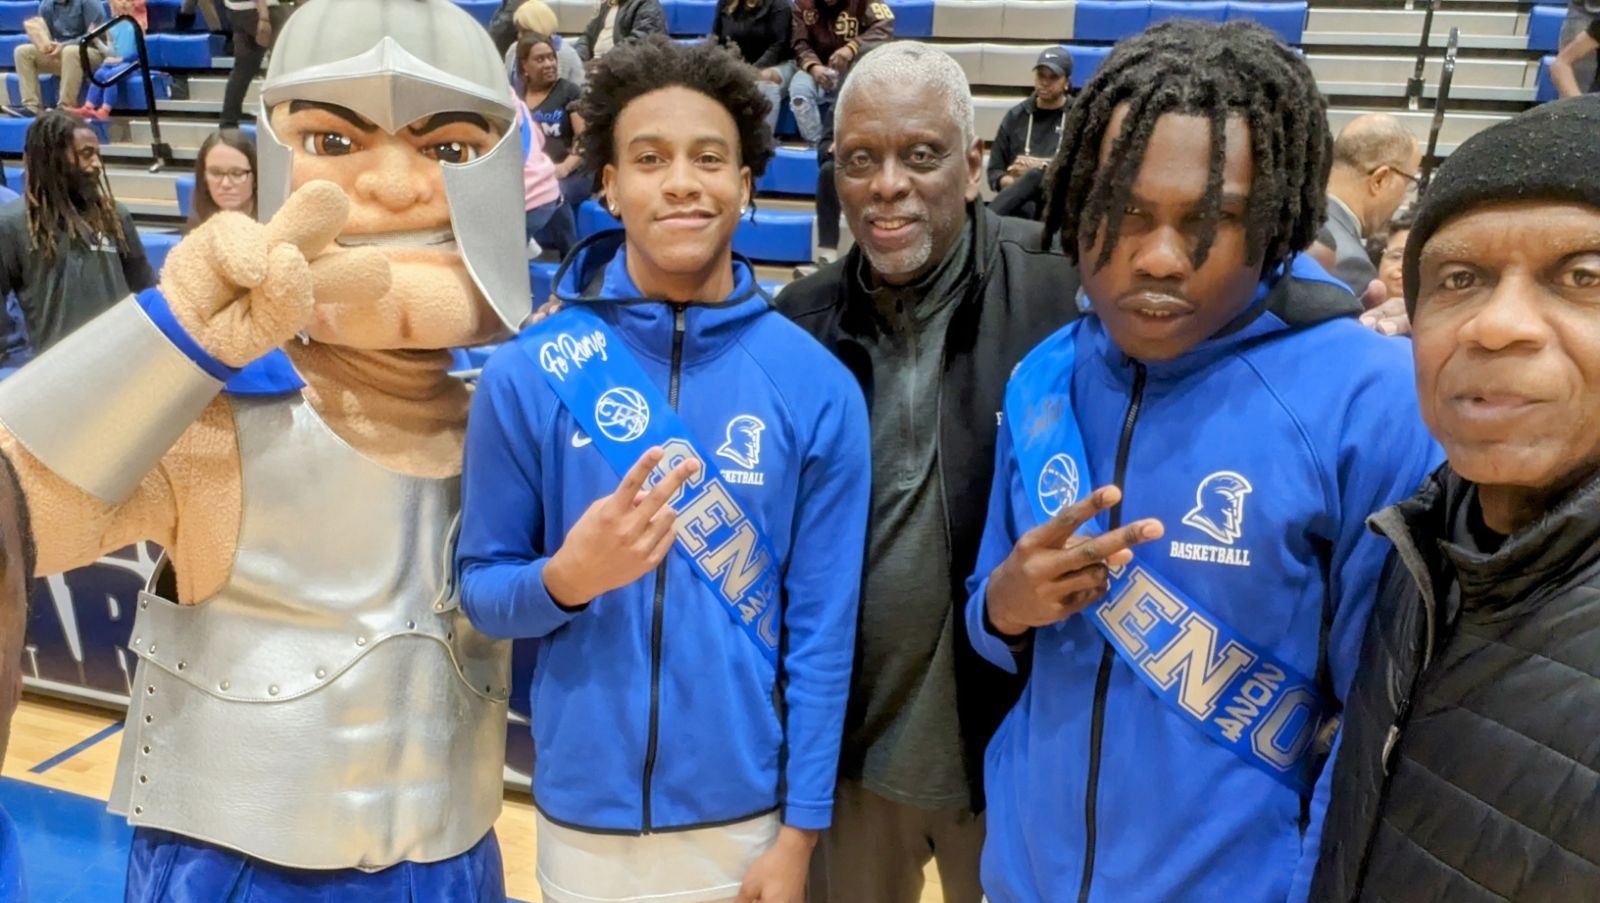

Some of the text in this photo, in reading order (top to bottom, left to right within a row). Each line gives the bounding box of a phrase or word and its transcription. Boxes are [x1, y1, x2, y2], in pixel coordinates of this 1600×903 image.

[720, 469, 764, 485] KETBALL
[1169, 541, 1251, 566] BASKETBALL
[1096, 560, 1259, 721] EN
